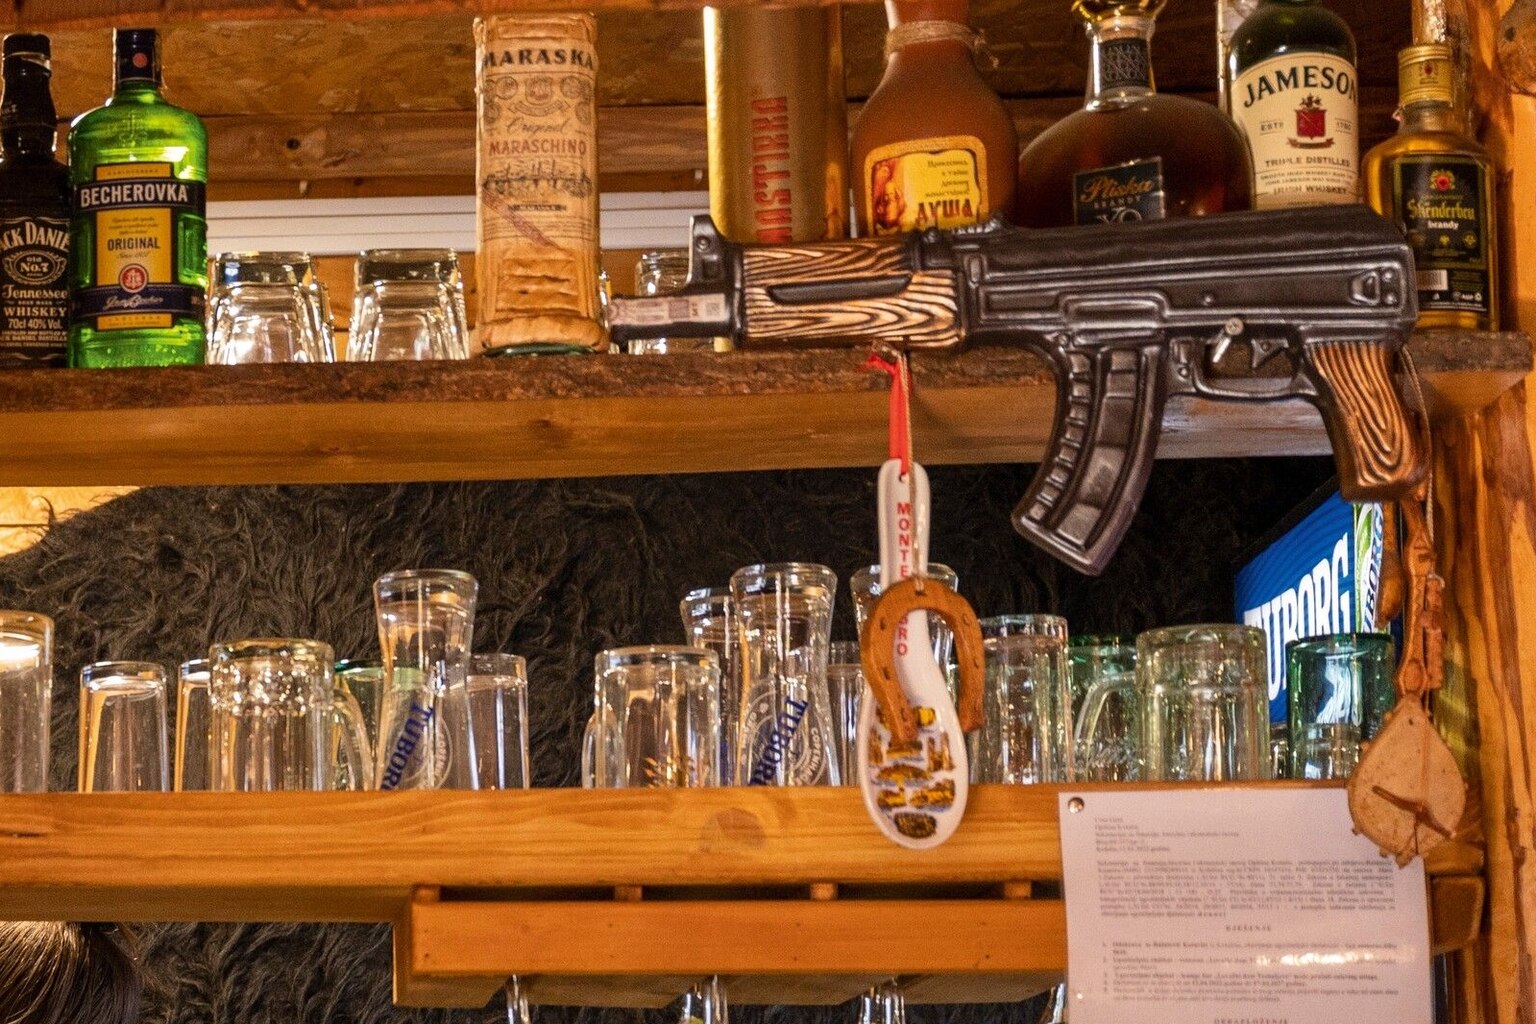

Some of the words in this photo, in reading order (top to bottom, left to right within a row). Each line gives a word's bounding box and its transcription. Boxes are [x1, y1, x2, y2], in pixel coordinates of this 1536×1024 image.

[483, 49, 594, 70] MARASKA
[1243, 65, 1357, 109] JAMESON
[488, 138, 587, 157] MARASCHINO
[81, 183, 188, 208] BECHEROVKA
[1427, 219, 1460, 230] brandy
[24, 221, 71, 252] DANIE
[107, 237, 160, 251] ORIGINAL
[2, 284, 68, 299] Tennessee
[3, 306, 67, 317] WHISKEY
[8, 318, 26, 329] 70cl
[28, 318, 47, 329] 40%
[896, 502, 911, 657] MONTEGRO
[380, 702, 434, 790] TUBOR
[748, 696, 809, 786] TUBOR
